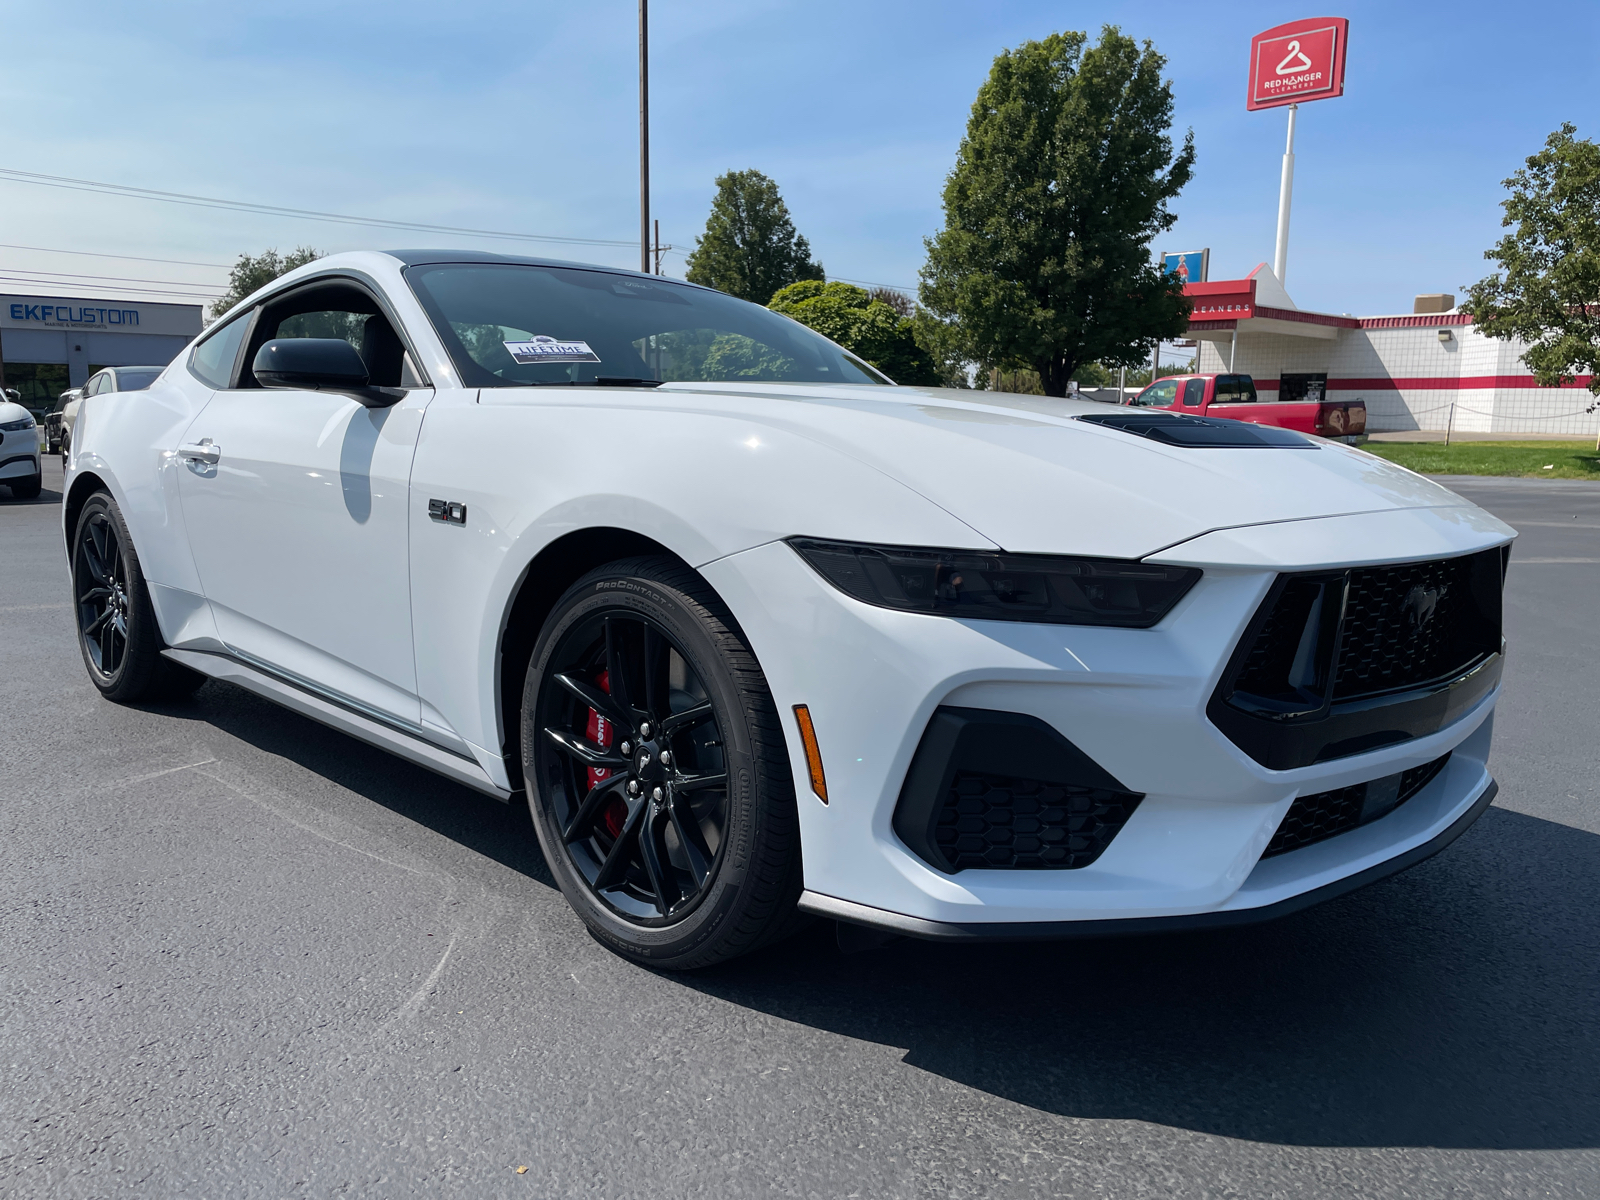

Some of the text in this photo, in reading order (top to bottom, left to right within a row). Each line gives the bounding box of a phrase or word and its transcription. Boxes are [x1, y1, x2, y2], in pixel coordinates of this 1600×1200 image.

[1265, 72, 1322, 89] RED HANGER
[1271, 82, 1313, 93] CLEANERS
[1193, 304, 1250, 314] LEANERS
[518, 346, 584, 354] LIFETIME
[428, 498, 468, 525] 5.0
